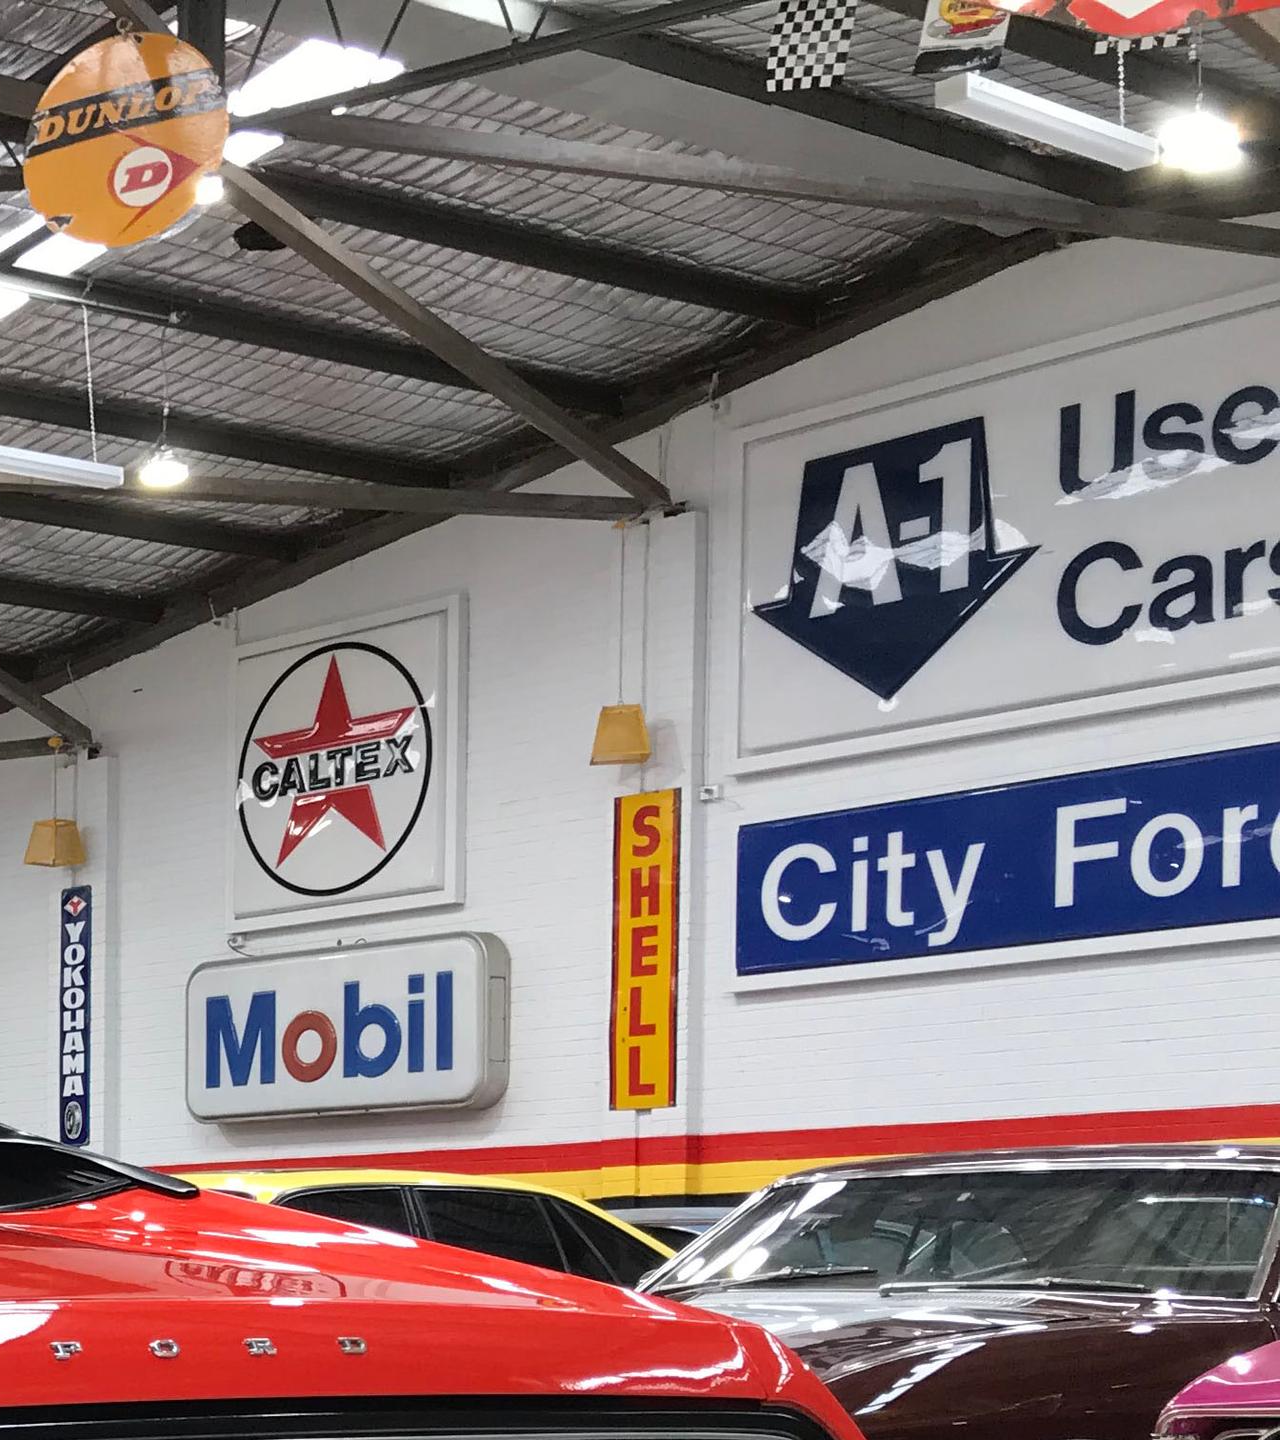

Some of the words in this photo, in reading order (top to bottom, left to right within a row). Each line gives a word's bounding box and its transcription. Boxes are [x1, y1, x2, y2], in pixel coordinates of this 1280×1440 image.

[809, 437, 972, 619] A-1
[1056, 539, 1280, 646] Car
[252, 735, 413, 801] CALTEX
[760, 831, 985, 946] City
[1053, 797, 1280, 908] For
[62, 921, 86, 1097] YOKOHAMA
[628, 804, 661, 1097] SHELL
[205, 970, 453, 1089] Mobil
